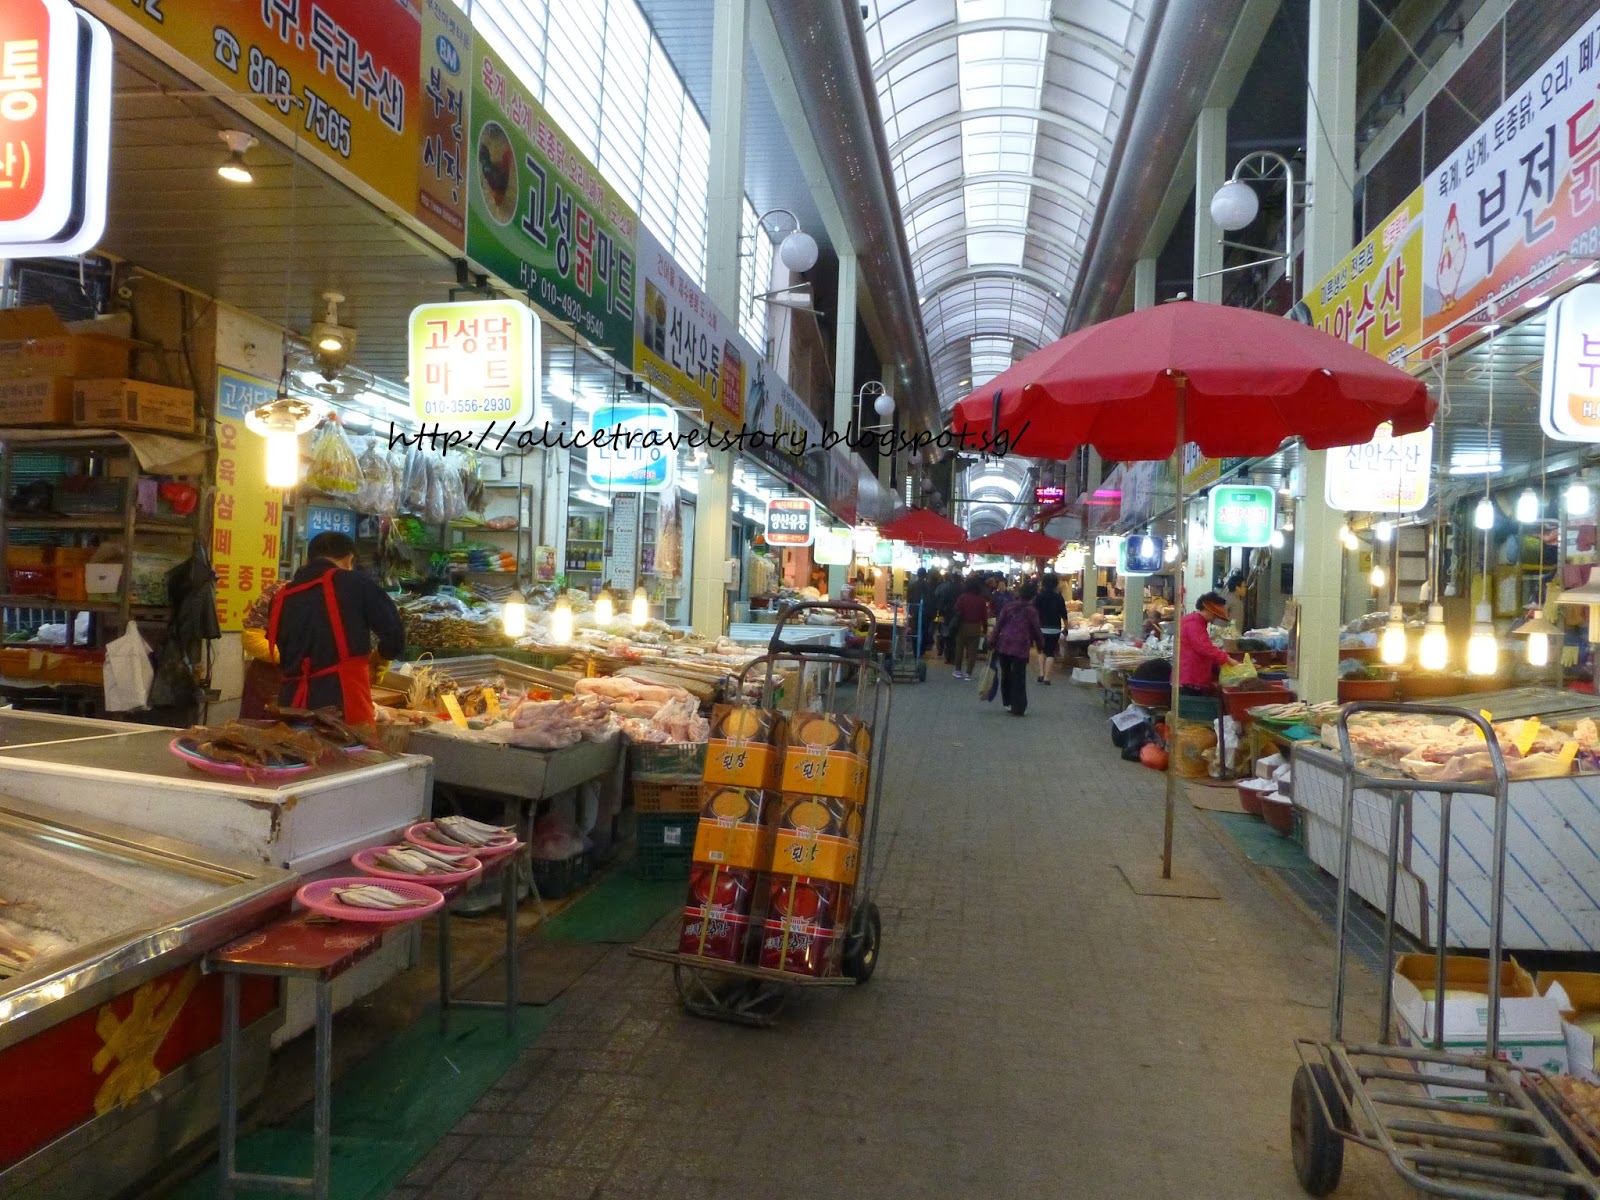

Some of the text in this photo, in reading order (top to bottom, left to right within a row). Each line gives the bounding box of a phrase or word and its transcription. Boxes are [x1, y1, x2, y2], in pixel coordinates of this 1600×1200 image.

[248, 46, 352, 158] 803-7565
[522, 152, 633, 321] 고성닭마트
[541, 276, 605, 341] 010-4920-9540
[425, 317, 512, 354] 고성닭
[670, 305, 720, 401] 선산유통
[424, 397, 512, 415] 010-3556-2930
[1345, 443, 1421, 473] 신안수산
[313, 511, 351, 533] 선산유통
[771, 513, 808, 531] 양산유통
